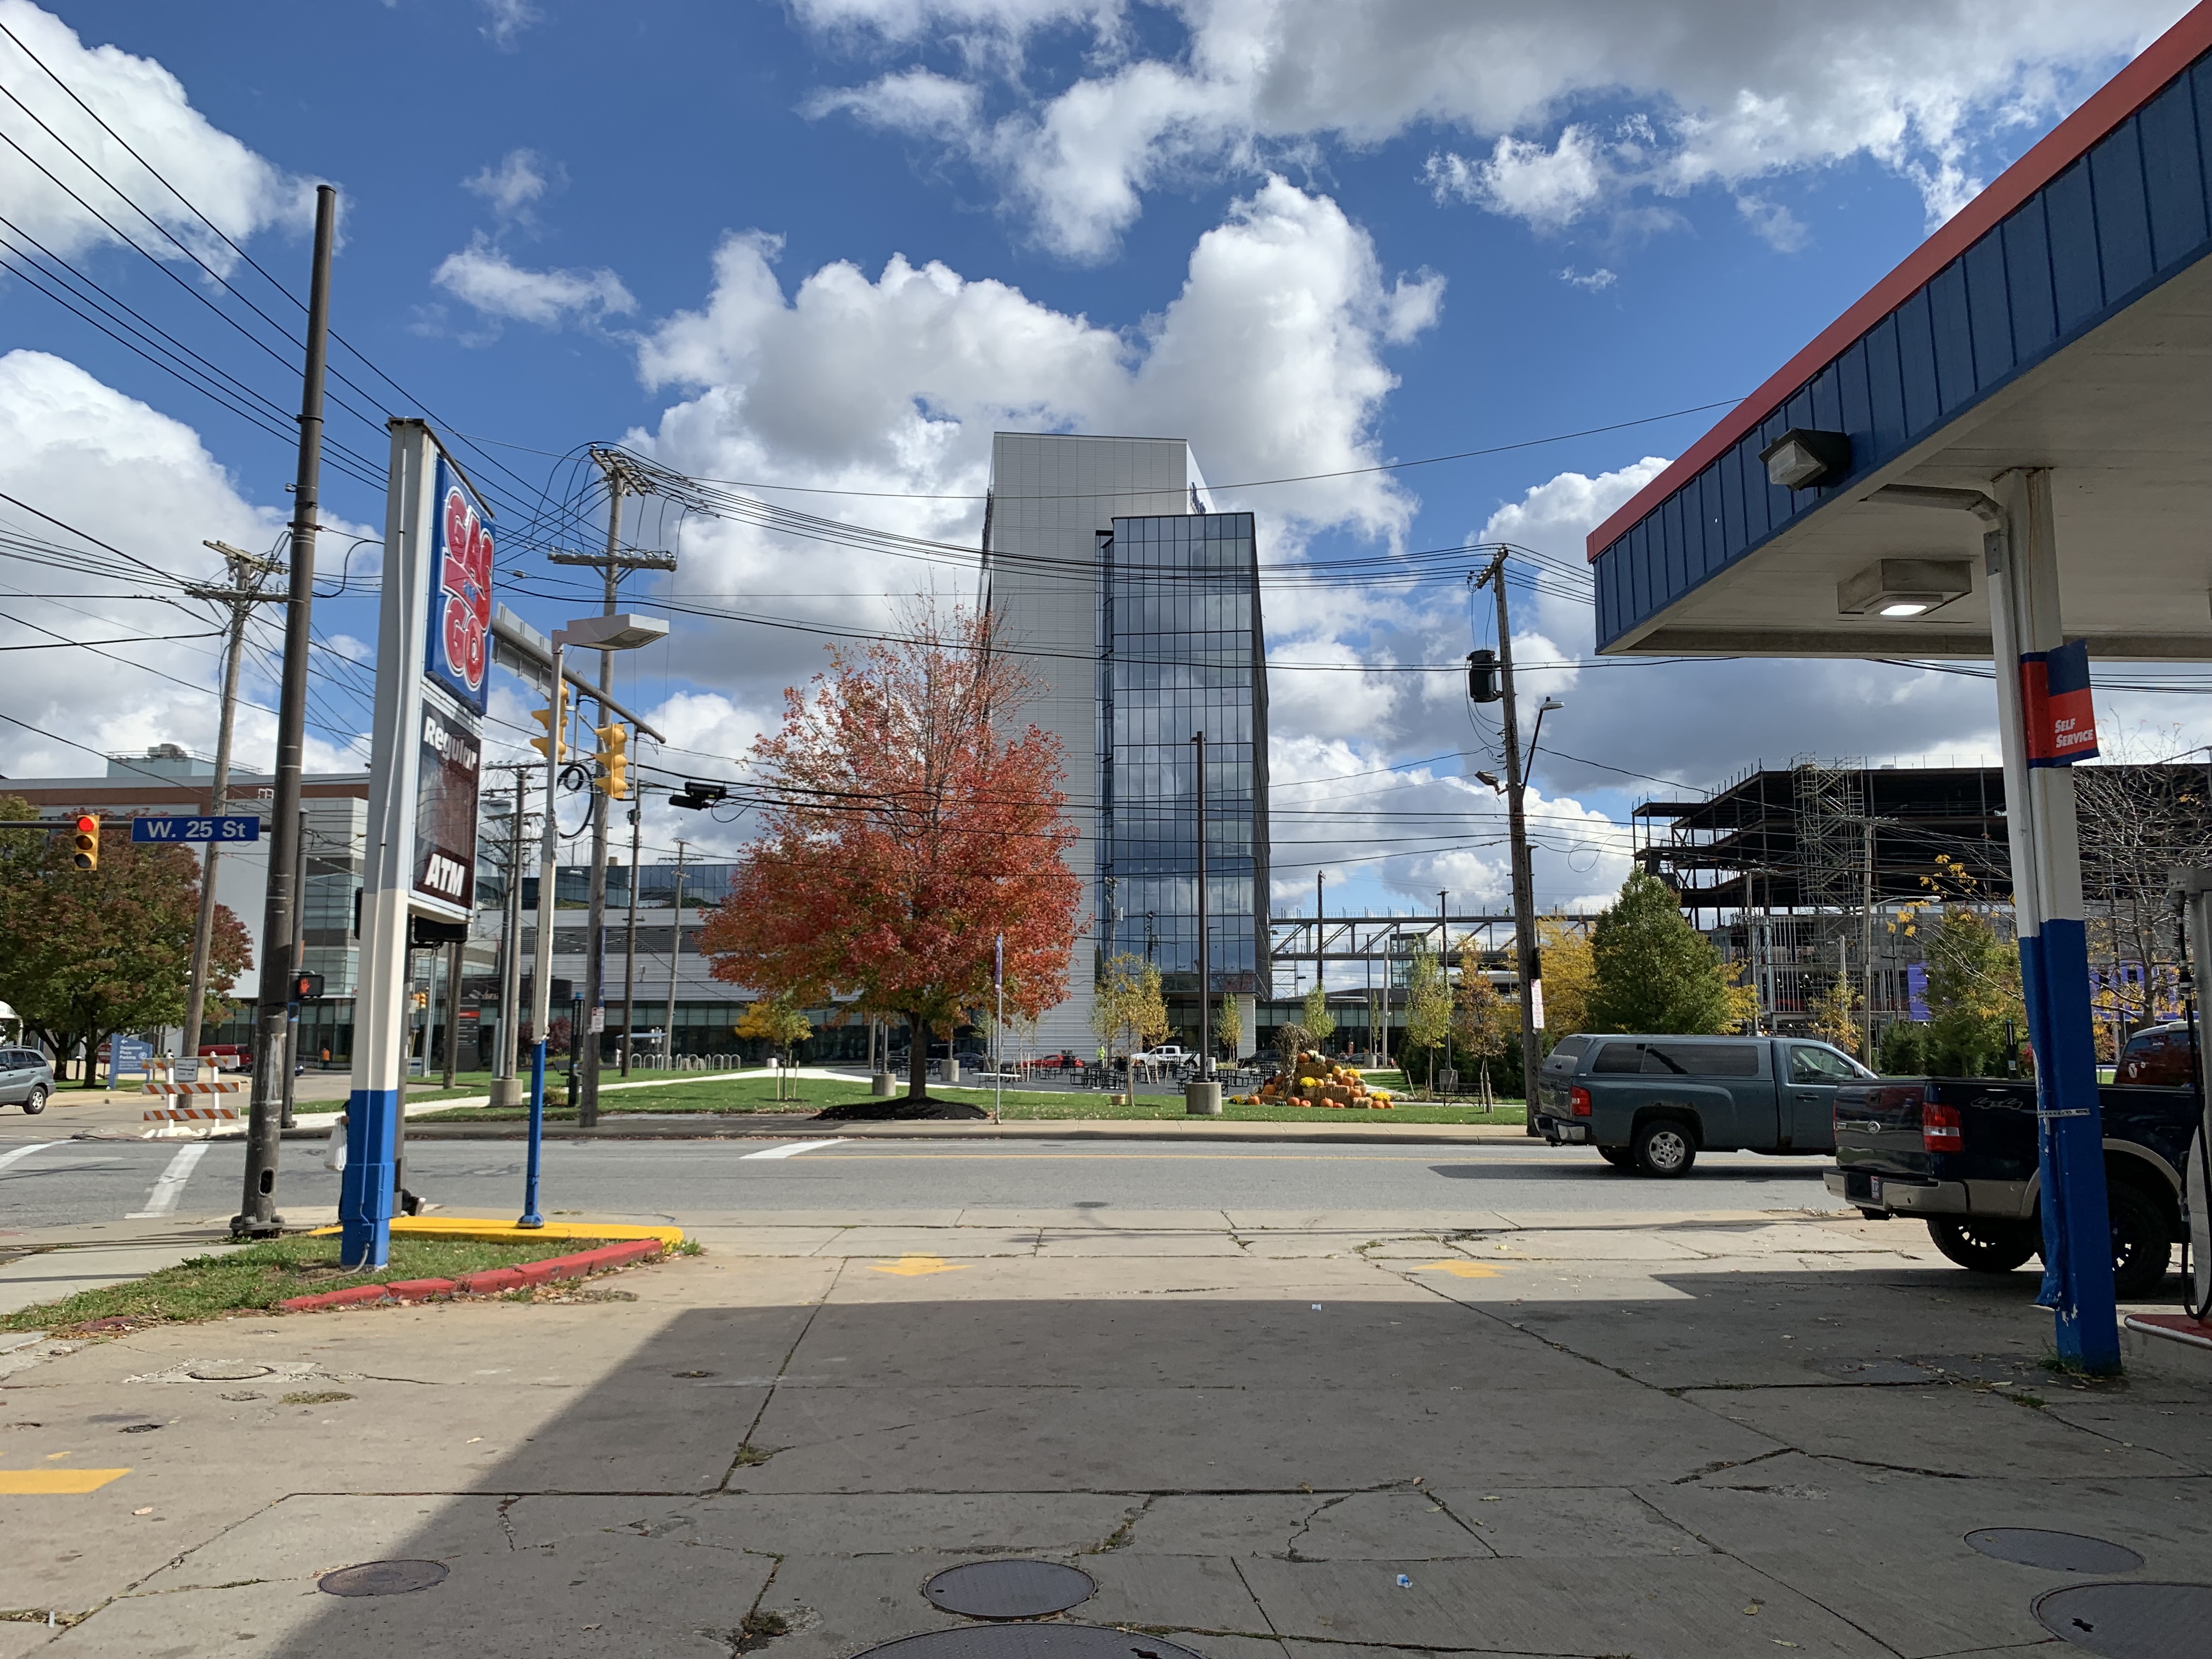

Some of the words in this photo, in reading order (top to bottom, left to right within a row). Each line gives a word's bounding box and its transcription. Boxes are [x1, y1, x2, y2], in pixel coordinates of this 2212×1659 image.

[423, 715, 477, 771] Regular
[2056, 729, 2094, 748] SERVICE
[146, 821, 176, 838] W.
[185, 820, 213, 838] 25
[222, 820, 246, 838] St
[424, 853, 465, 897] ATM
